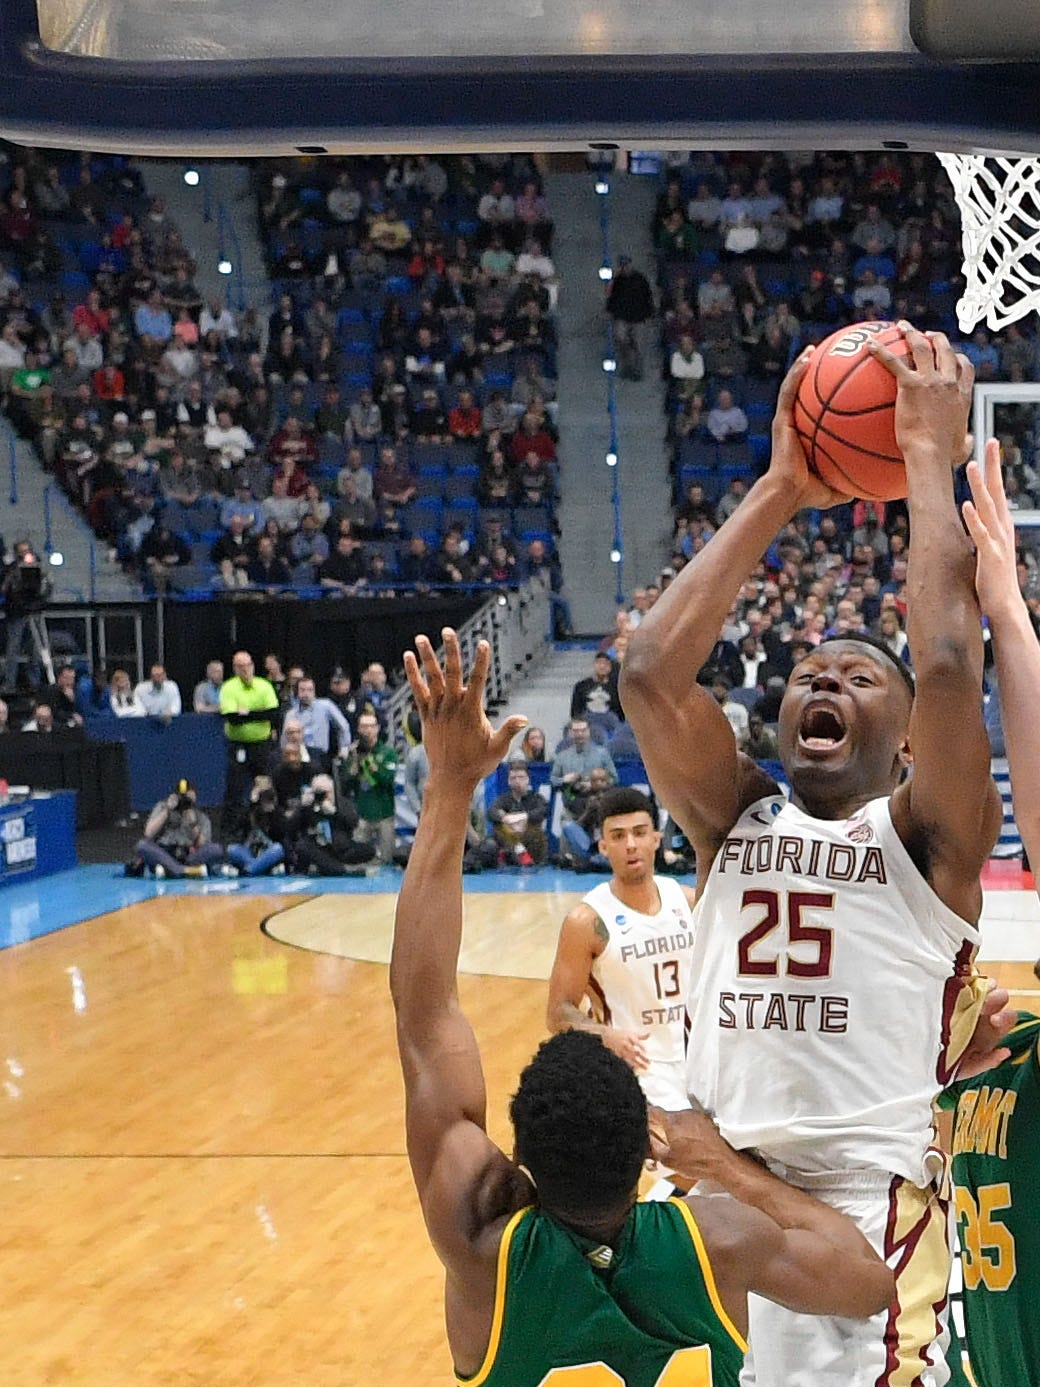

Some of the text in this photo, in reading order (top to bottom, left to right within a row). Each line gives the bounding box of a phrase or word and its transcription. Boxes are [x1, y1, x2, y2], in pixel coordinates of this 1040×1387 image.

[718, 834, 888, 885] FLORIDA
[736, 888, 837, 981] 25
[653, 960, 681, 1000] 13
[641, 1004, 685, 1025] STAT
[719, 991, 850, 1034] STATE
[955, 1182, 1017, 1291] 35
